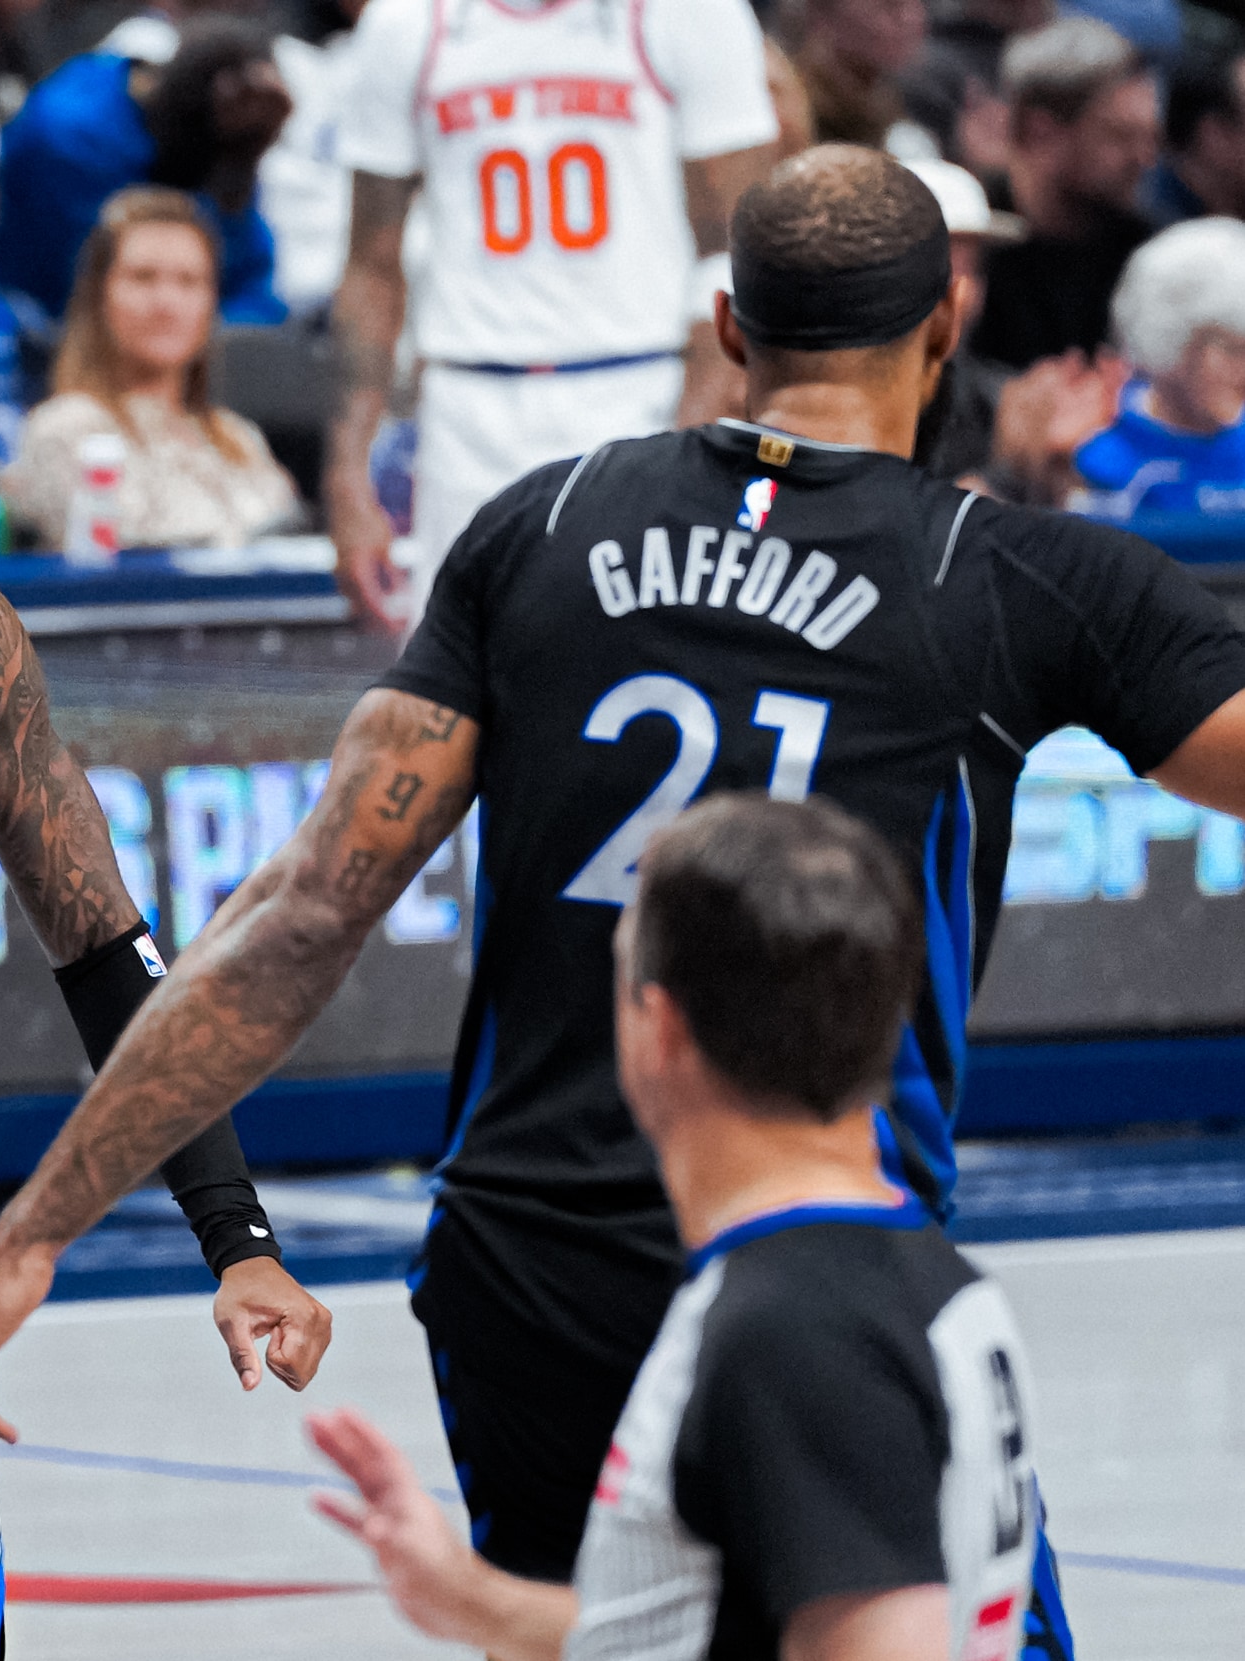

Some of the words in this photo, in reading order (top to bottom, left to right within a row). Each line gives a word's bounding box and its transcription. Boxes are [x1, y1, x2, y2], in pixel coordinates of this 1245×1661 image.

[479, 140, 610, 256] 00
[587, 525, 881, 651] GAFFORD
[558, 669, 833, 908] 21
